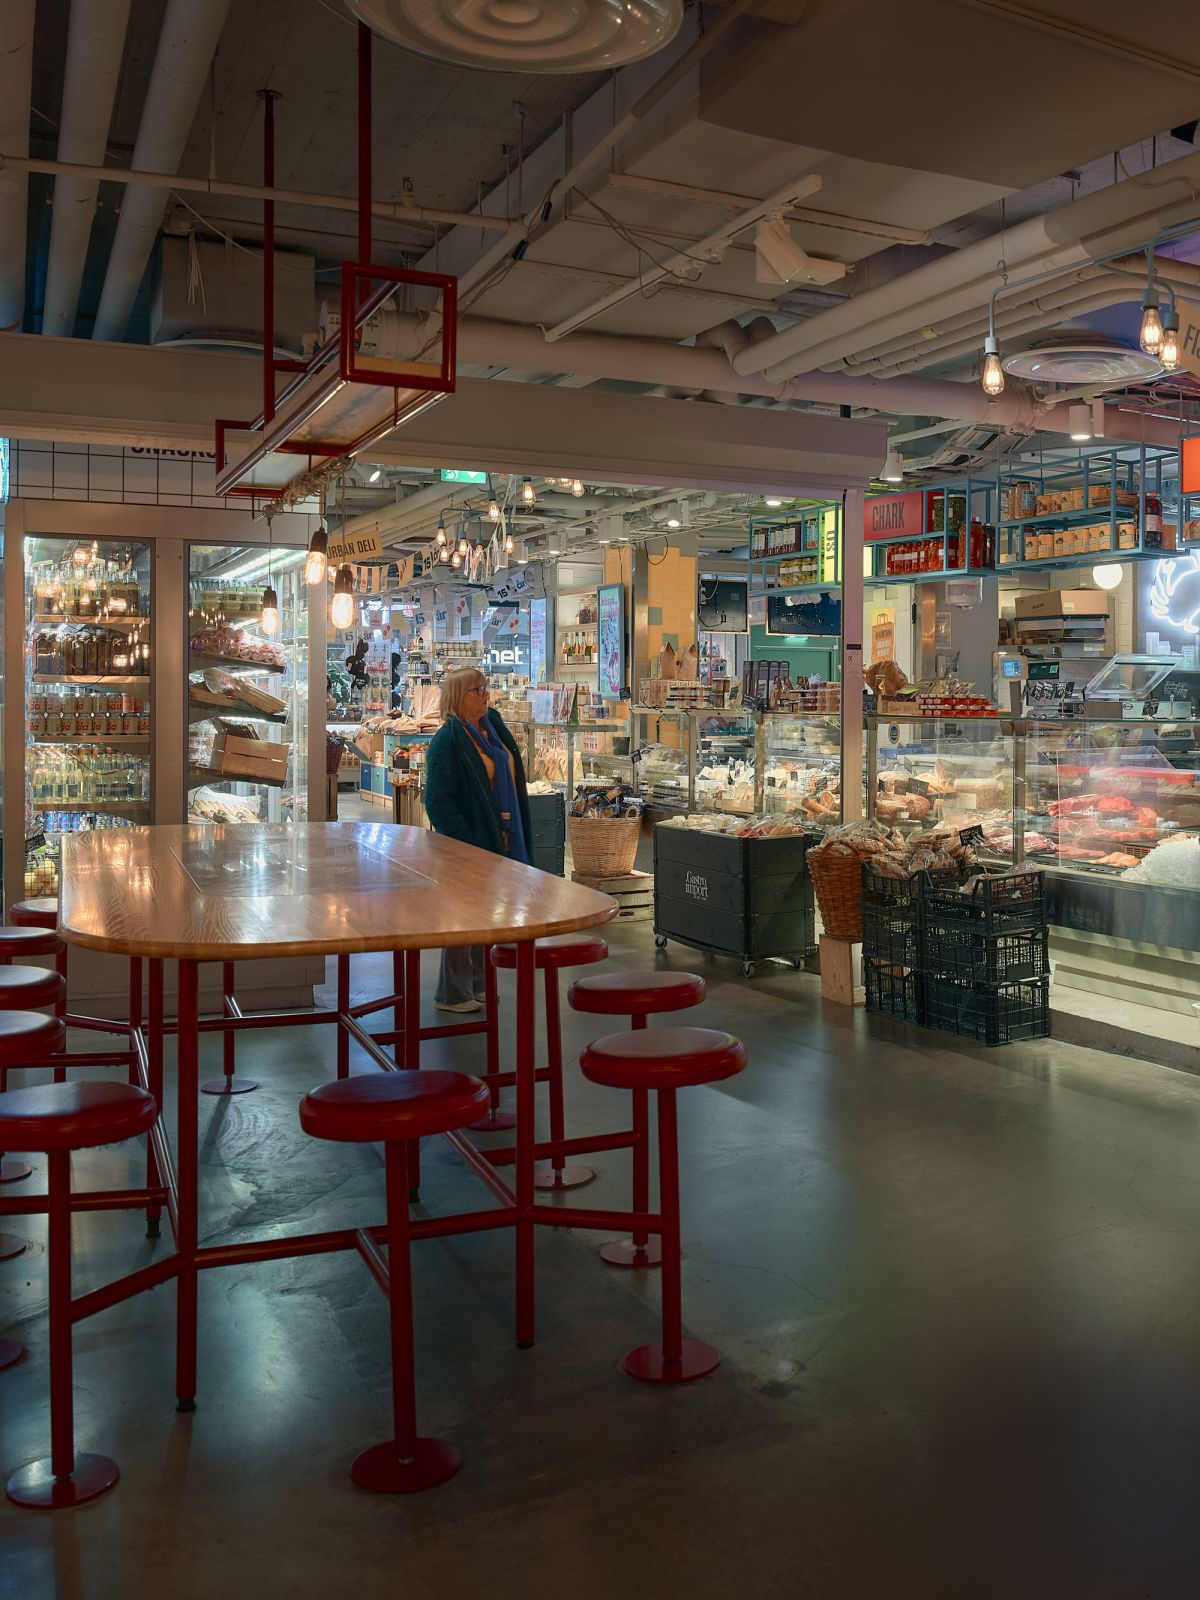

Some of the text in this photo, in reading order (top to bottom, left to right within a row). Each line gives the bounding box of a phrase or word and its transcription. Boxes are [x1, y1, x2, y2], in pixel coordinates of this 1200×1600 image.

[872, 501, 905, 532] CHARK
[327, 538, 377, 560] URBAN DELI
[497, 588, 509, 599] 15
[415, 612, 425, 625] 15
[484, 645, 523, 664] net
